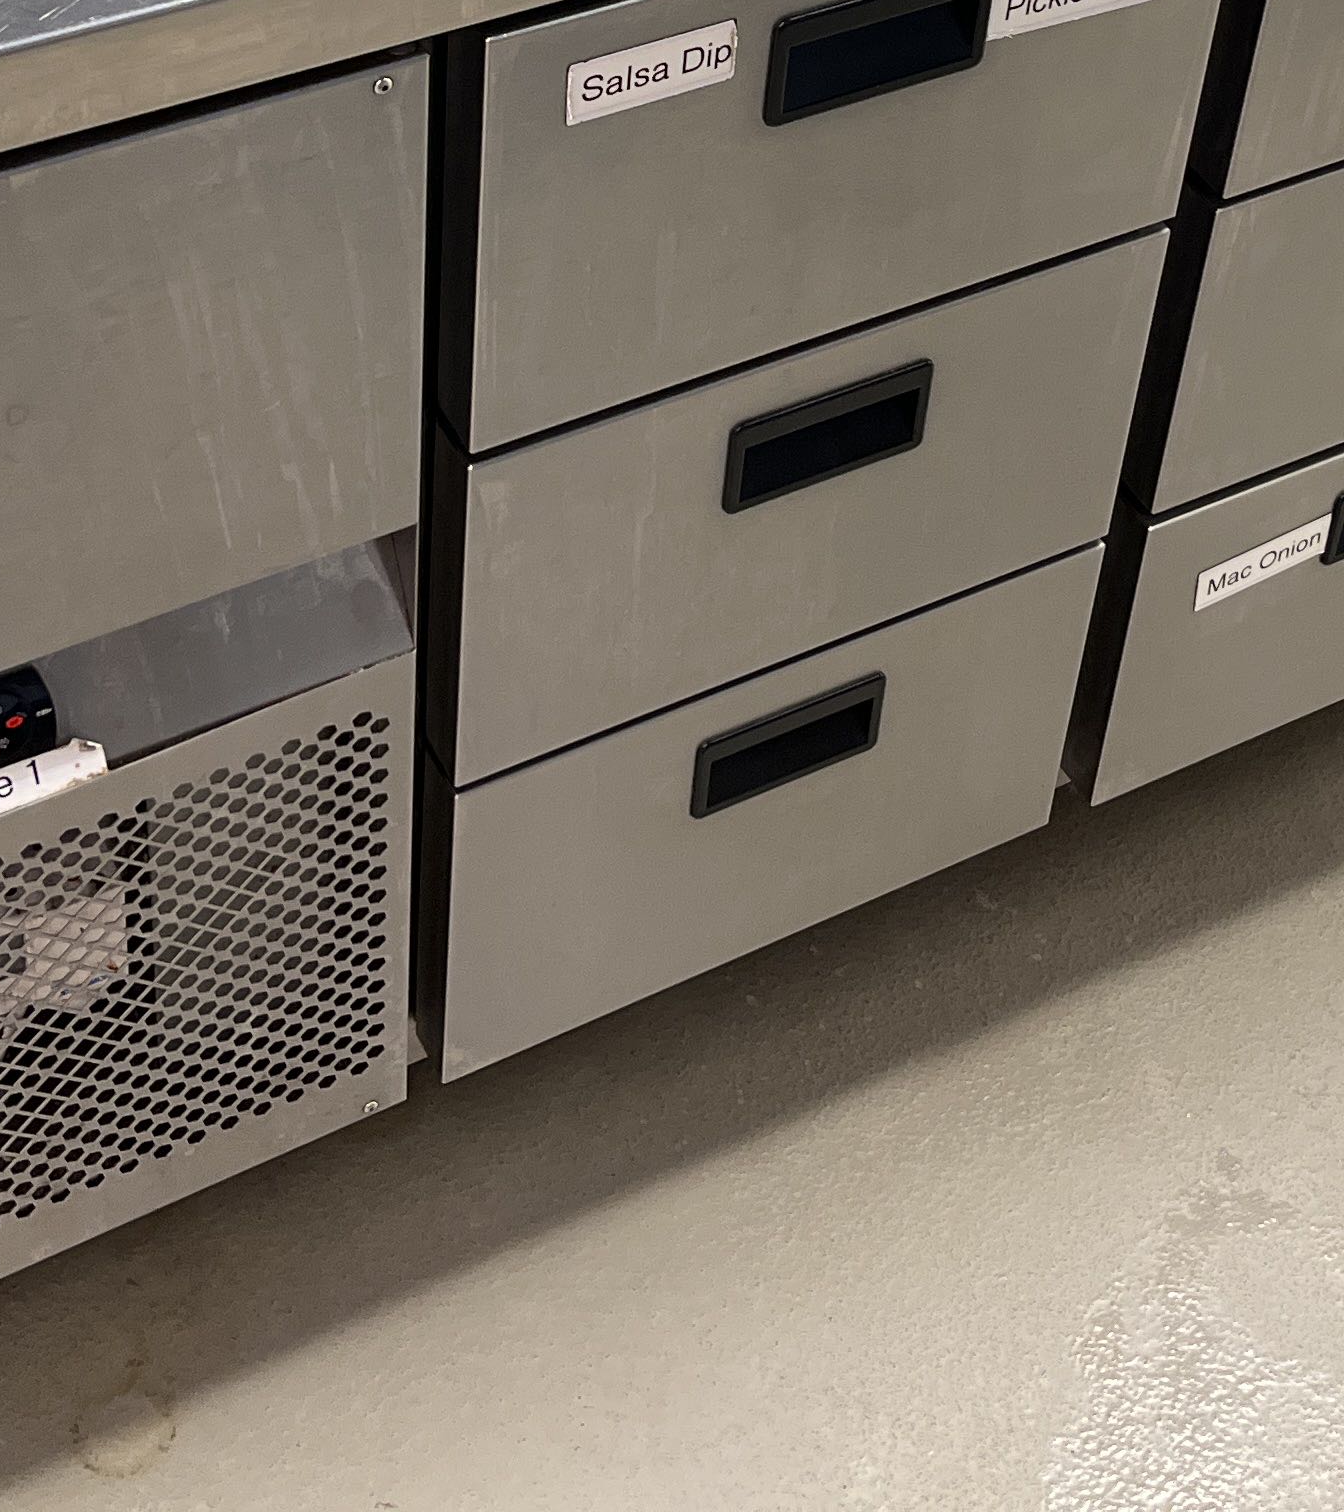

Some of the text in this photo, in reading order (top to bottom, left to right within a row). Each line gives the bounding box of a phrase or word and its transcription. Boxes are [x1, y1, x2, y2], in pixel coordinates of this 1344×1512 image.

[581, 40, 733, 103] Salsa Dip
[1207, 531, 1322, 595] Mac Onion
[27, 760, 42, 786] 1
